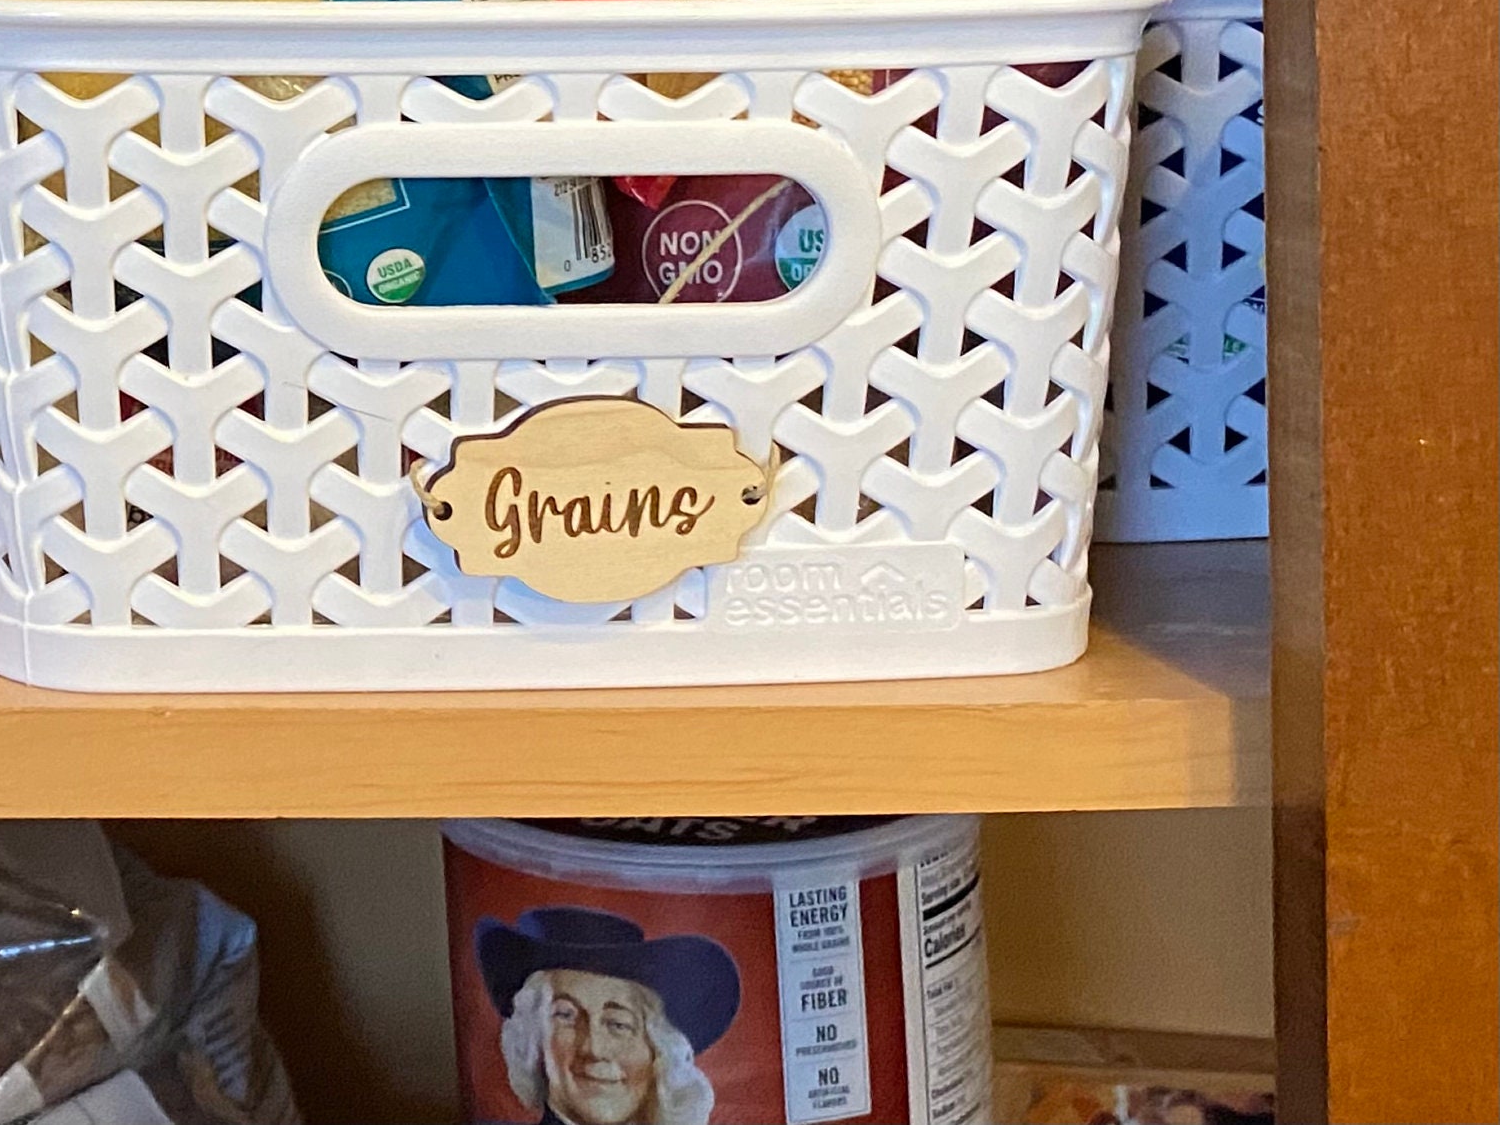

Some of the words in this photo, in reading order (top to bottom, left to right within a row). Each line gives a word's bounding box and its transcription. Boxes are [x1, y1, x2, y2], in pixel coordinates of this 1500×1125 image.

[660, 230, 720, 256] NON
[377, 257, 414, 279] USDA
[484, 466, 715, 559] Grains
[726, 562, 843, 594] room
[725, 580, 948, 626] essentials
[789, 885, 848, 909] LASTING
[790, 902, 849, 928] ENERGY
[801, 988, 848, 1012] FIBER
[816, 1024, 838, 1043] NO
[818, 1066, 840, 1086] NO
